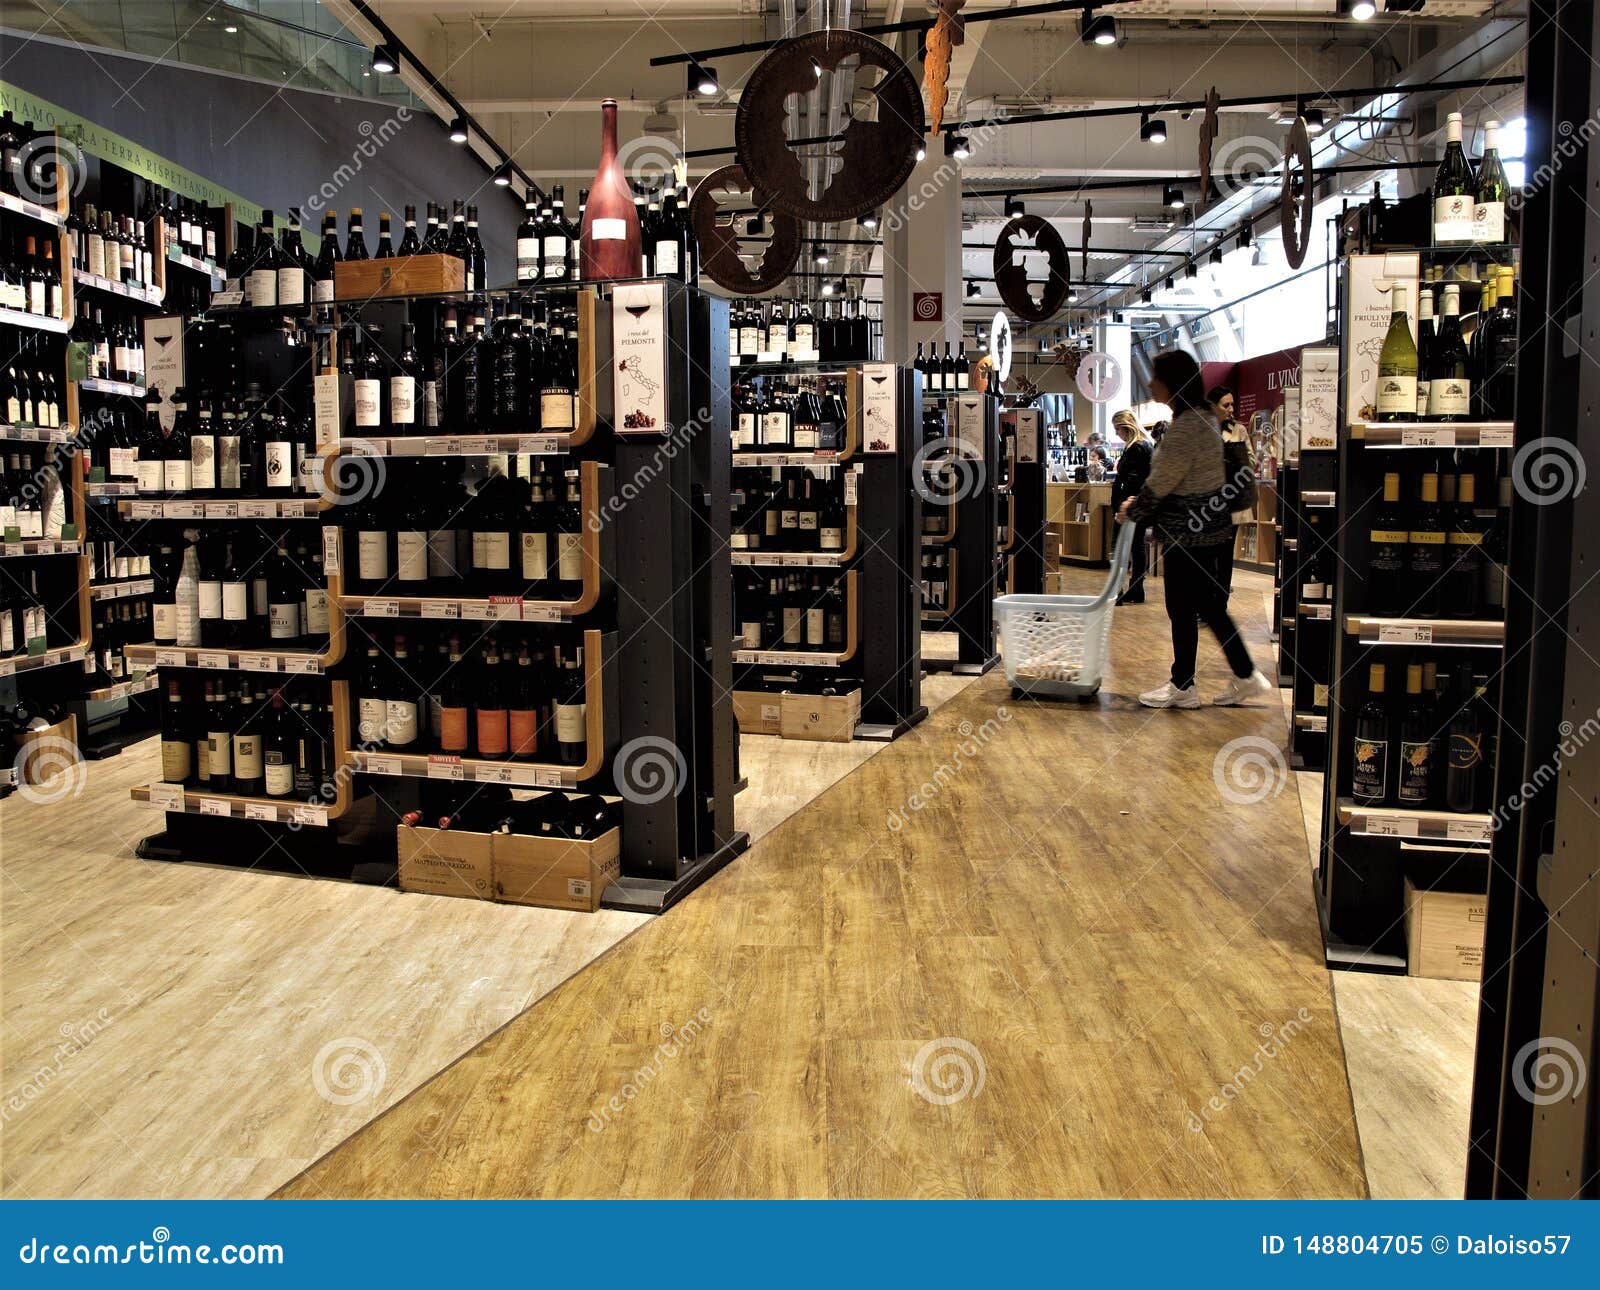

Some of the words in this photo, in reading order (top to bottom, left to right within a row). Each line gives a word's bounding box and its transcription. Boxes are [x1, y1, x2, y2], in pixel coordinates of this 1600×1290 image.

[102, 136, 141, 166] TERRA
[146, 159, 215, 201] RISPETTANDO
[621, 337, 656, 346] PIEMONTE
[1268, 372, 1278, 390] IL
